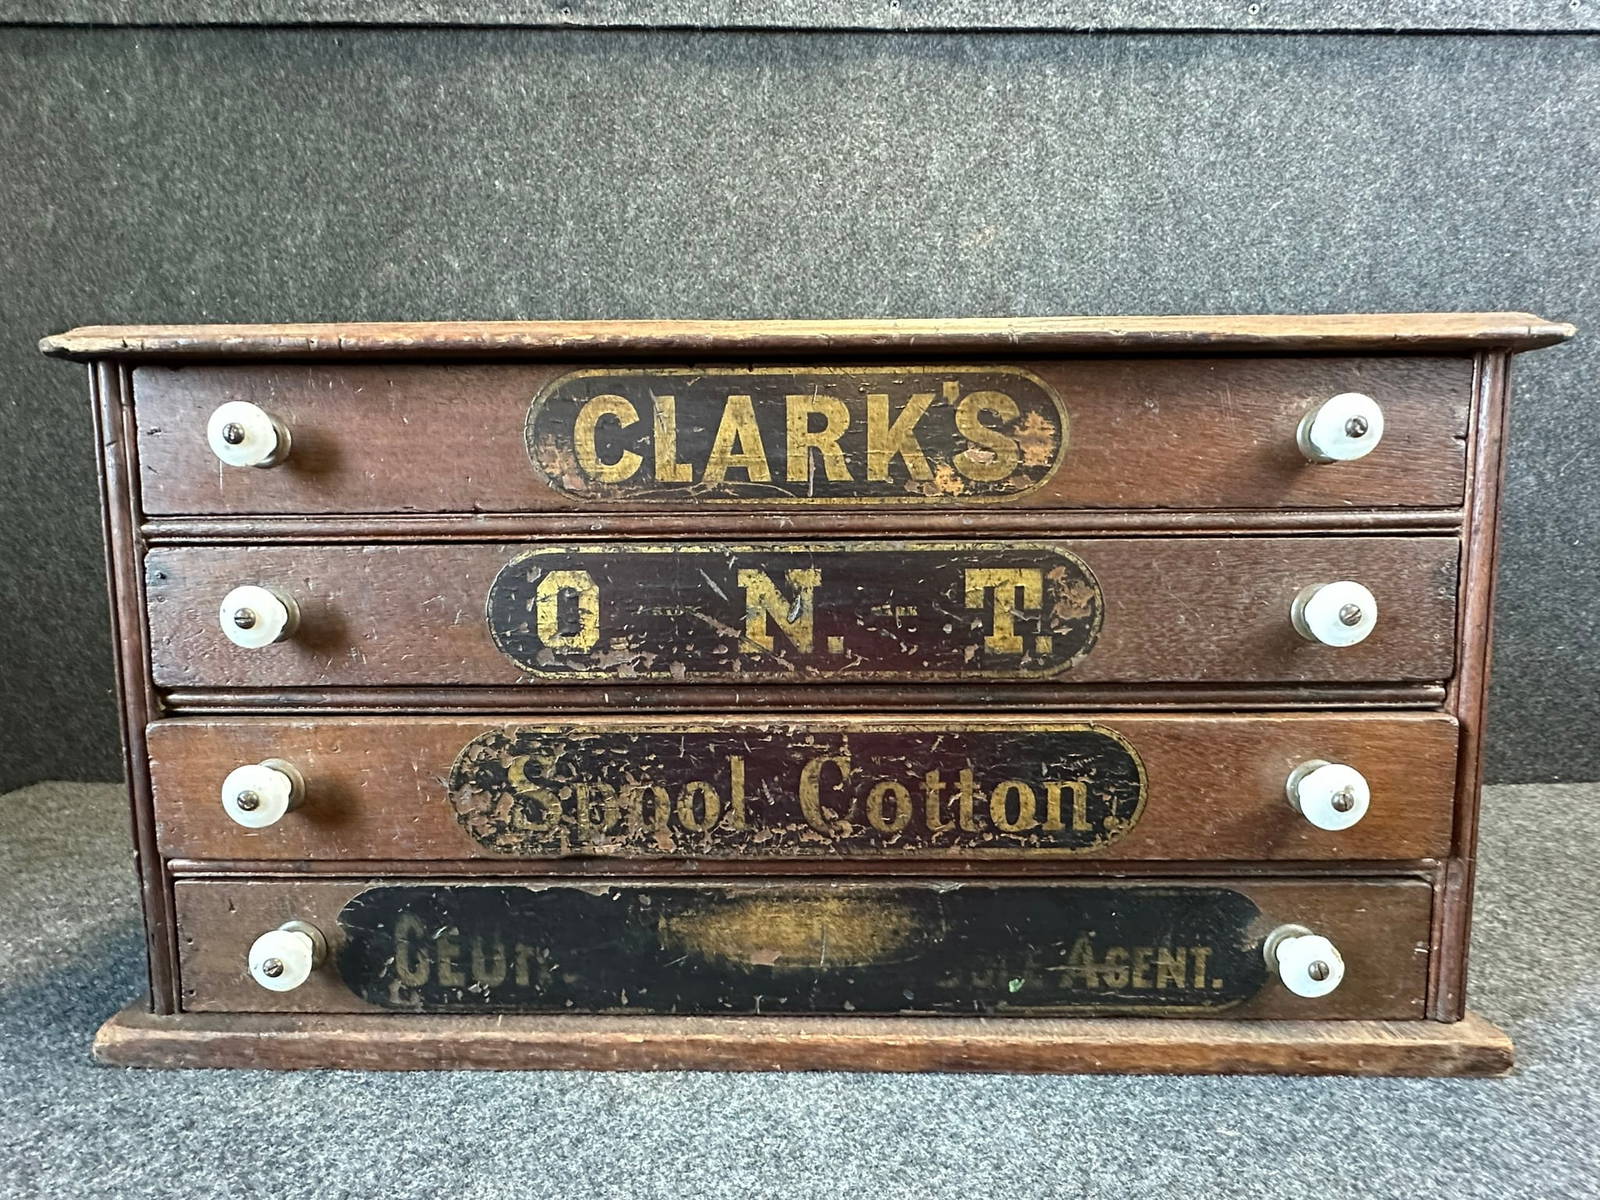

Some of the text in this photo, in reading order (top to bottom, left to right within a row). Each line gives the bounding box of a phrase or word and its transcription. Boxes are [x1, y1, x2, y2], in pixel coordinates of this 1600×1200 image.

[572, 380, 1022, 484] CLARK'S
[737, 567, 845, 655] N.
[964, 567, 1053, 655] T.
